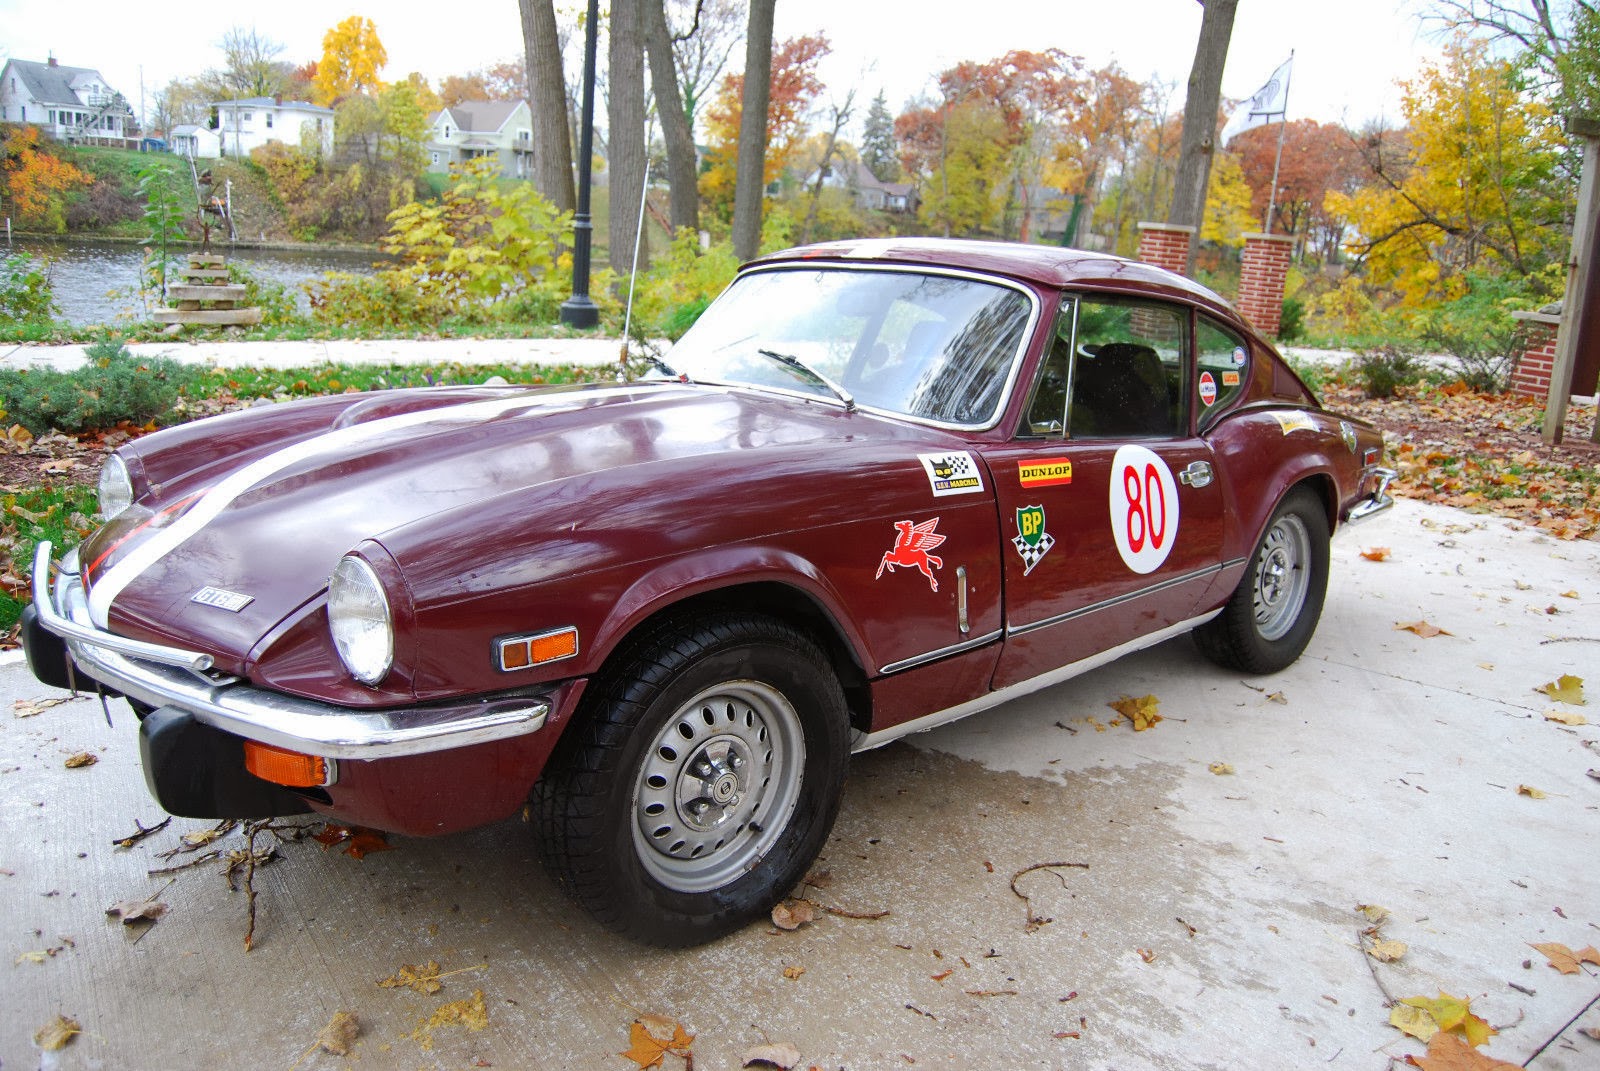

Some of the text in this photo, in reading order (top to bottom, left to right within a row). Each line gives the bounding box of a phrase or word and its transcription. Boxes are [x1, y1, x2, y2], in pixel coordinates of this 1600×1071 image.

[1021, 465, 1070, 478] DUNLOP
[950, 478, 979, 488] MARCHAL
[1123, 463, 1166, 553] 80
[1022, 512, 1042, 536] BP
